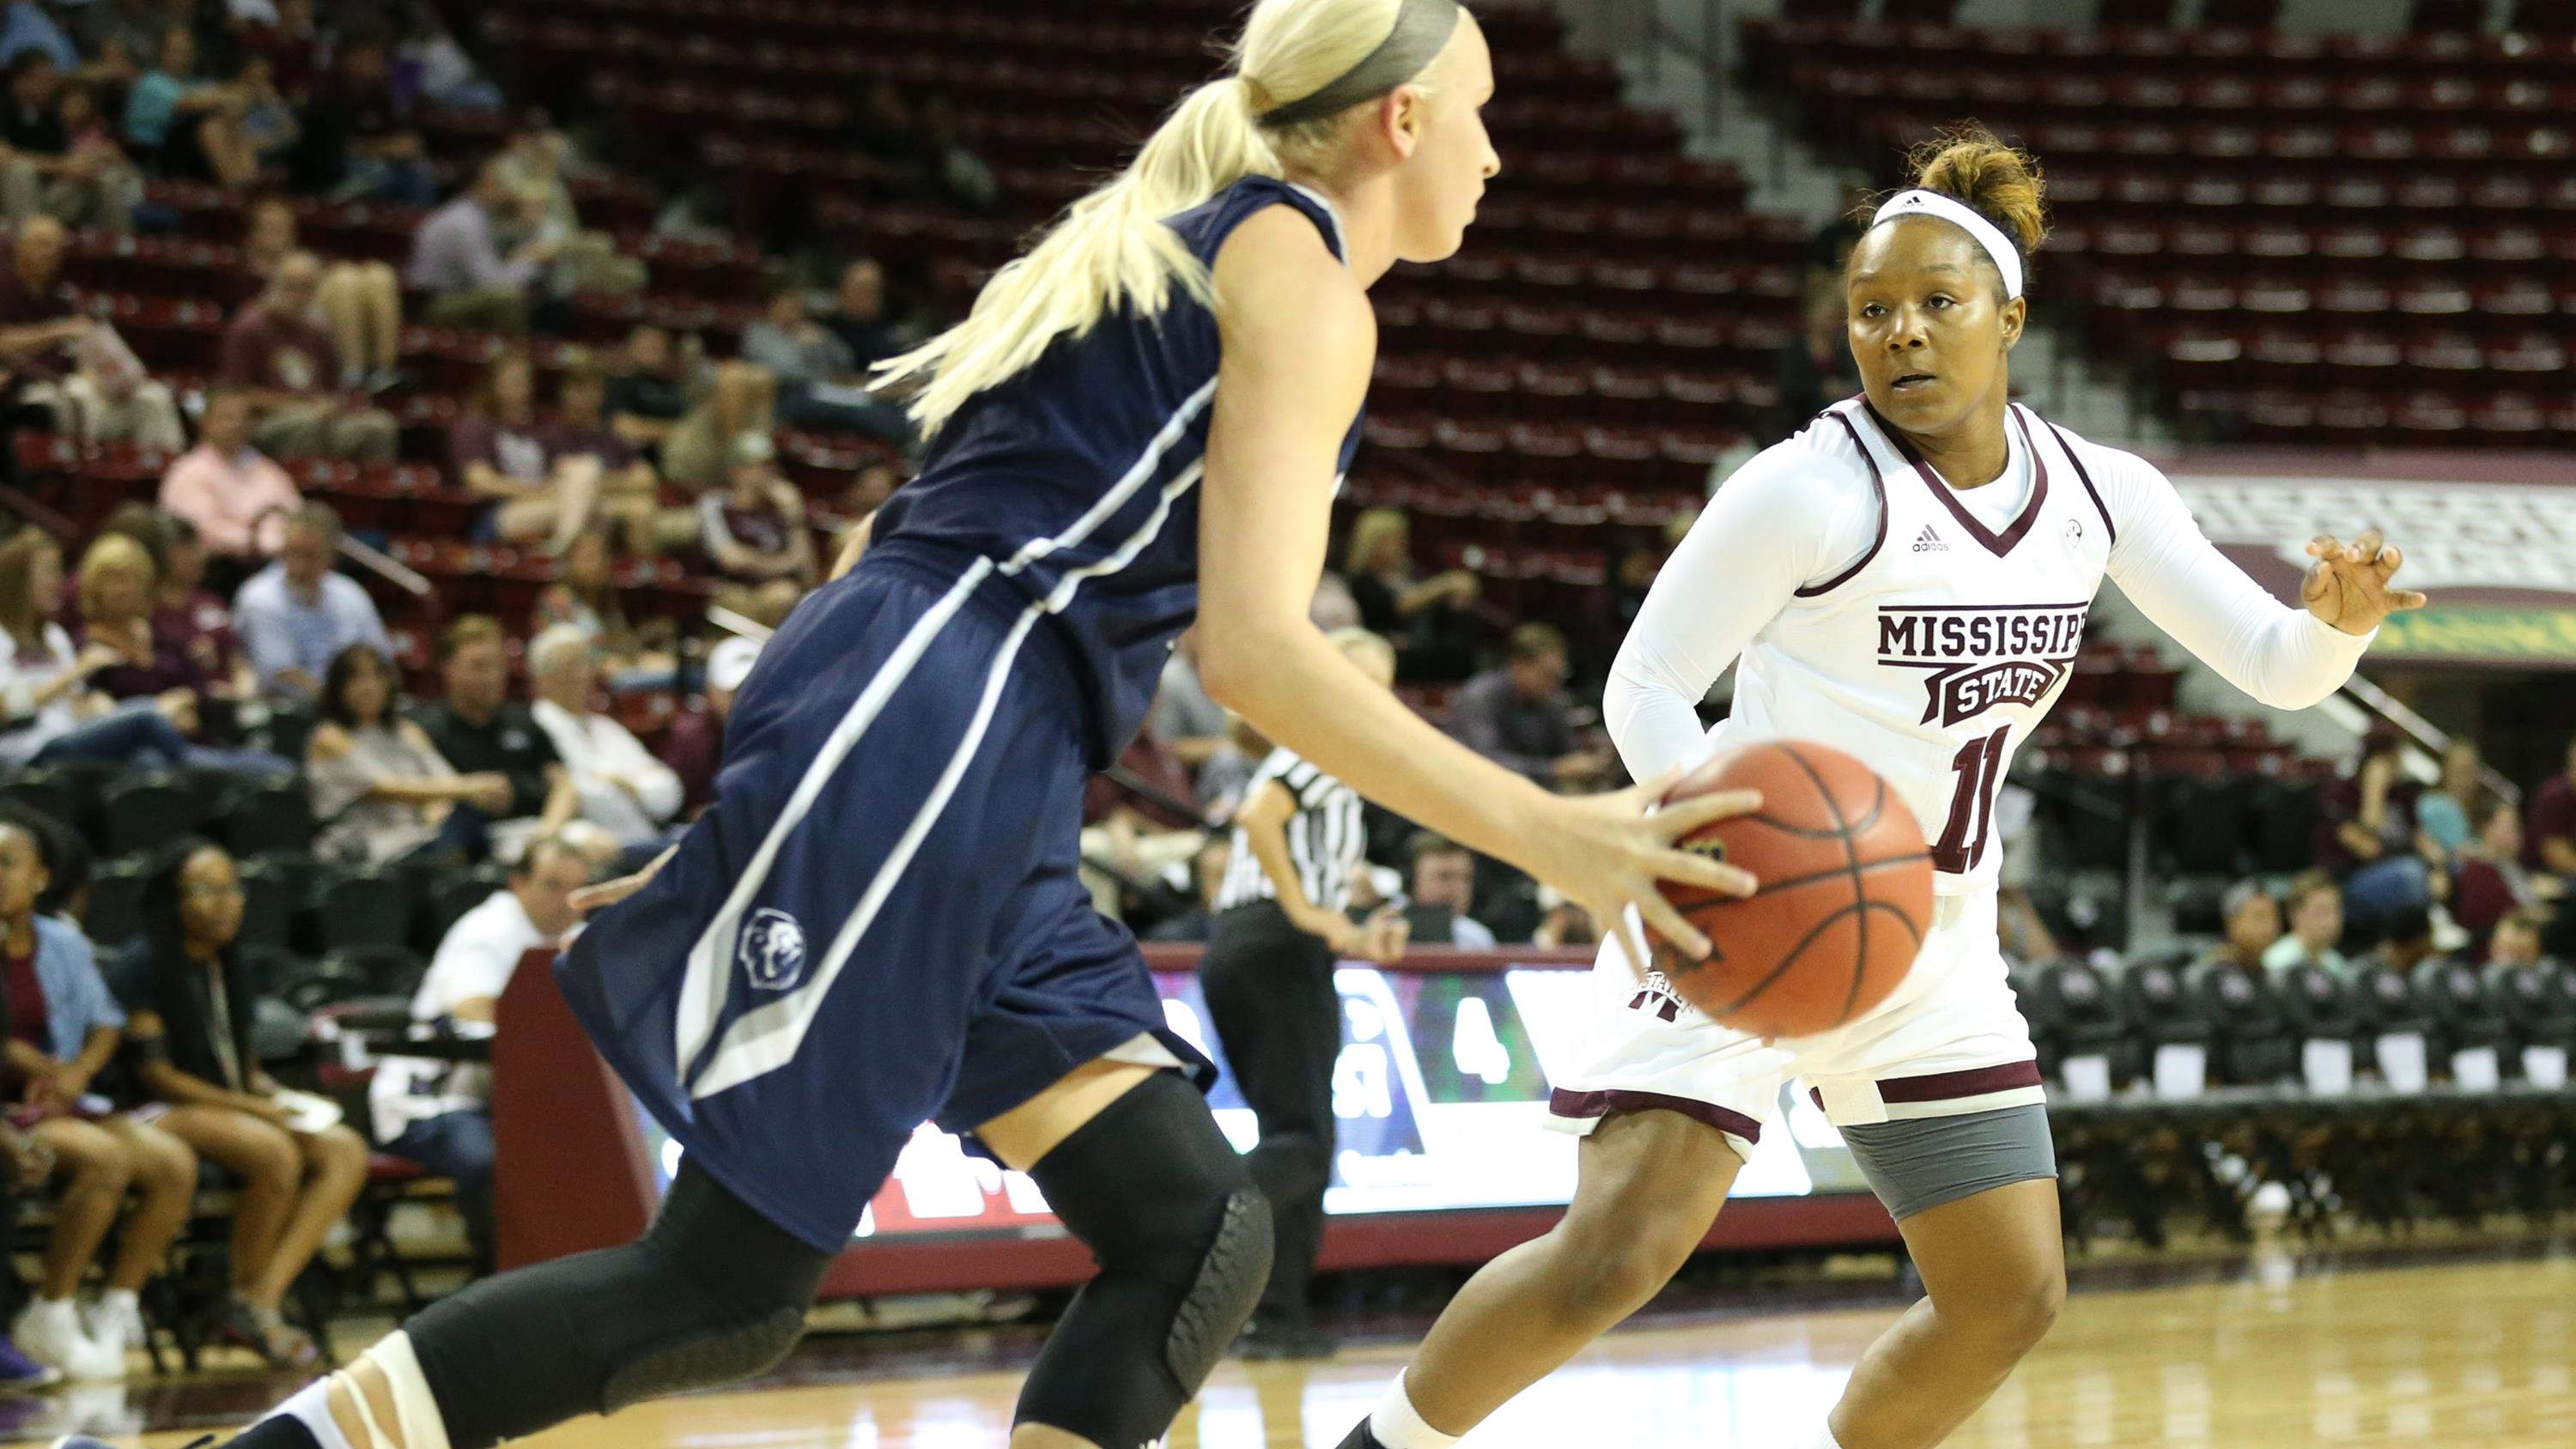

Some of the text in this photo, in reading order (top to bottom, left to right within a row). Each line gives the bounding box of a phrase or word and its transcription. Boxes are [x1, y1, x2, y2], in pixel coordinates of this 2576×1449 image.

[1912, 542, 1949, 552] adidas
[1957, 668, 2045, 713] STATE
[1928, 724, 2012, 874] 11
[1453, 997, 1509, 1084] 4
